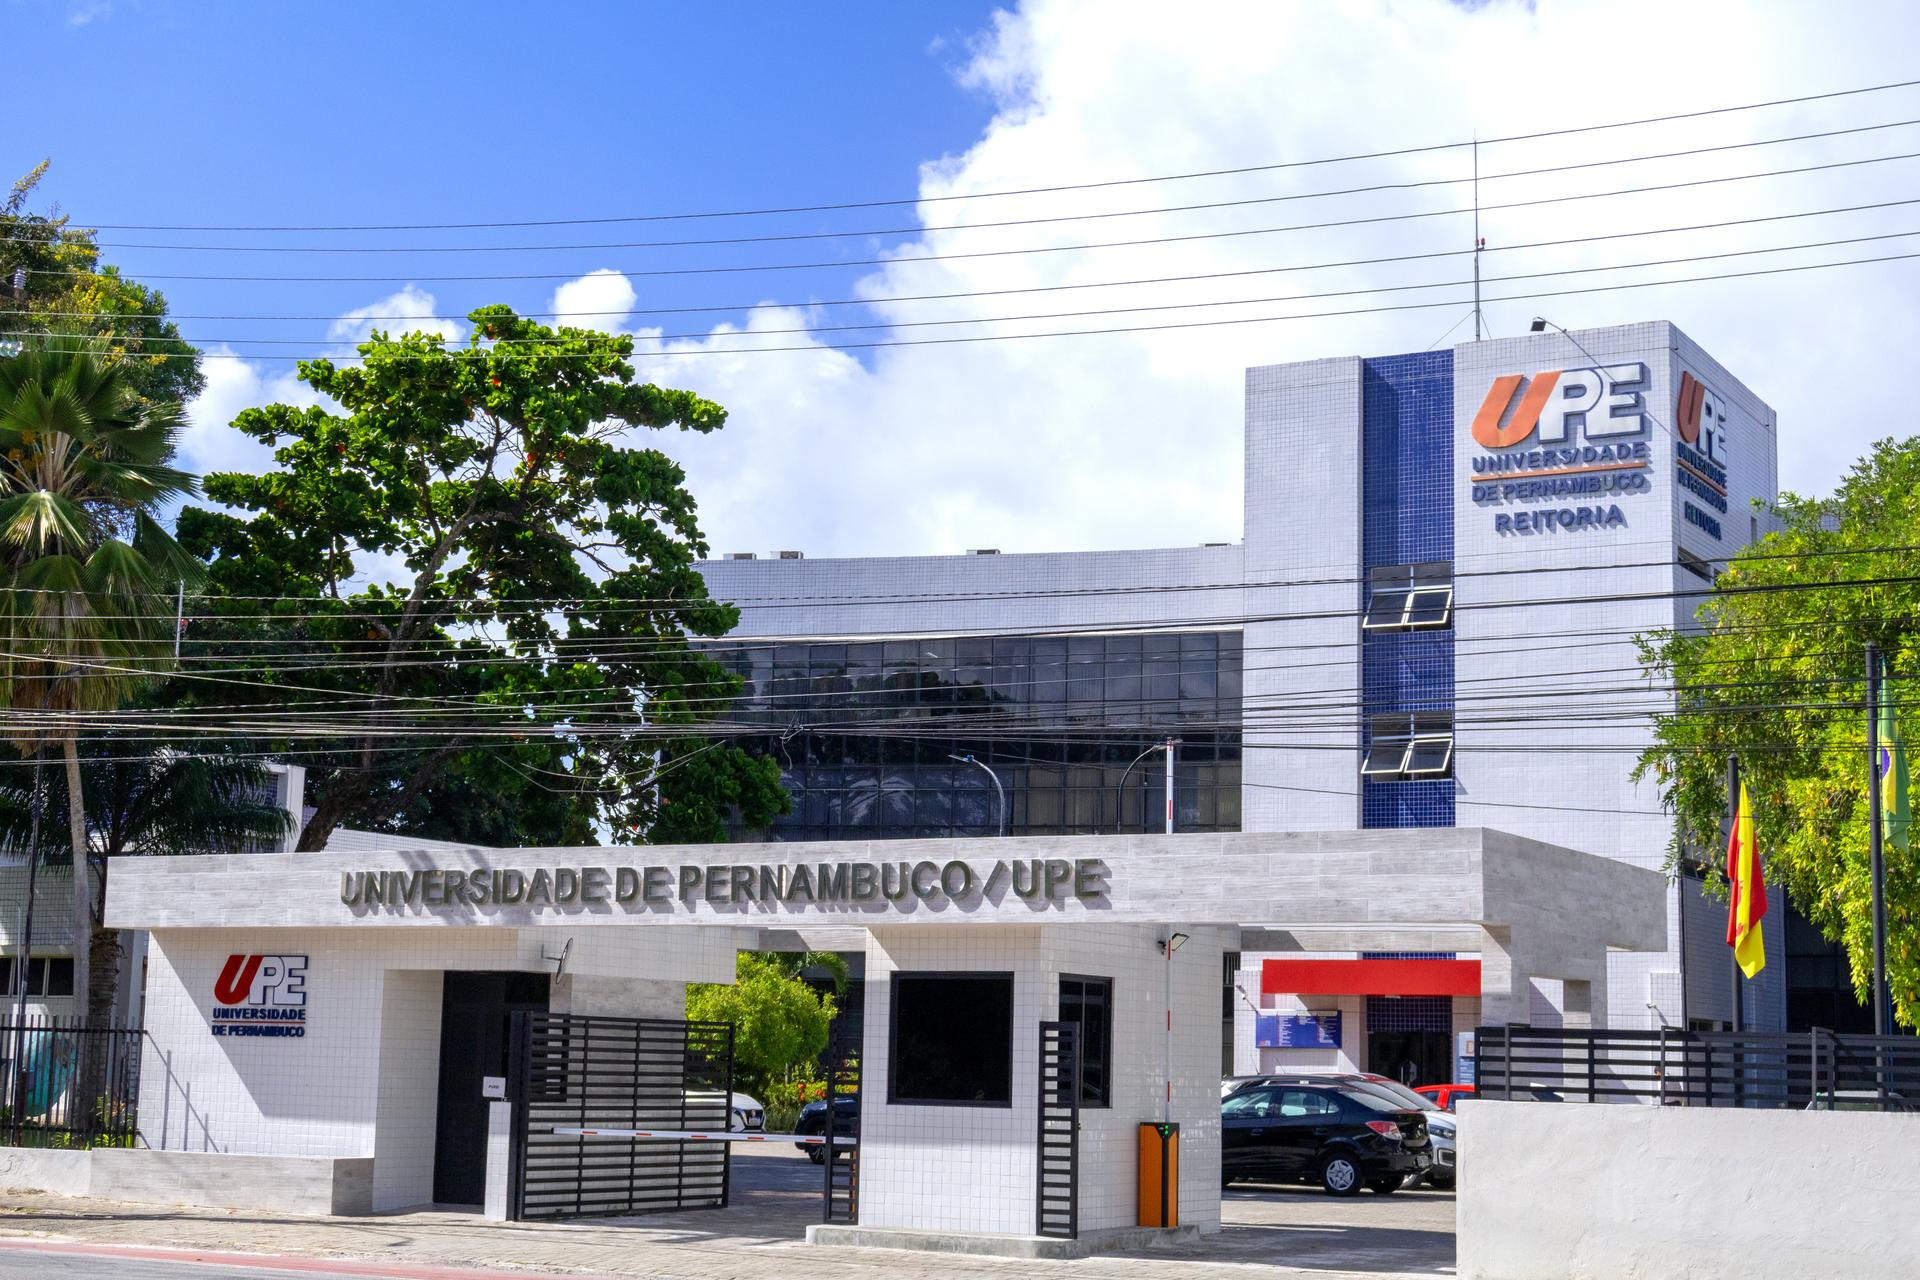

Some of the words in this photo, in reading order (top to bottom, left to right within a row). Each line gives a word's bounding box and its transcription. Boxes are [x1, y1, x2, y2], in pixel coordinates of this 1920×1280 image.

[1471, 361, 1645, 448] UPE
[1676, 371, 1727, 470] UPE
[1472, 441, 1646, 473] UNIVERSIDADE
[1472, 484, 1498, 502] DE
[1503, 472, 1645, 500] PERNAMBUCO
[1495, 504, 1624, 533] REITORIA
[1684, 501, 1722, 541] REITORIA
[341, 867, 606, 906] UNIVERSIDADE
[615, 866, 668, 903] DE
[214, 954, 308, 1005] UPE
[212, 1025, 226, 1036] DE
[228, 1025, 305, 1037] PERNAMBUCO
[213, 1008, 306, 1020] UNIVERSIDADE
